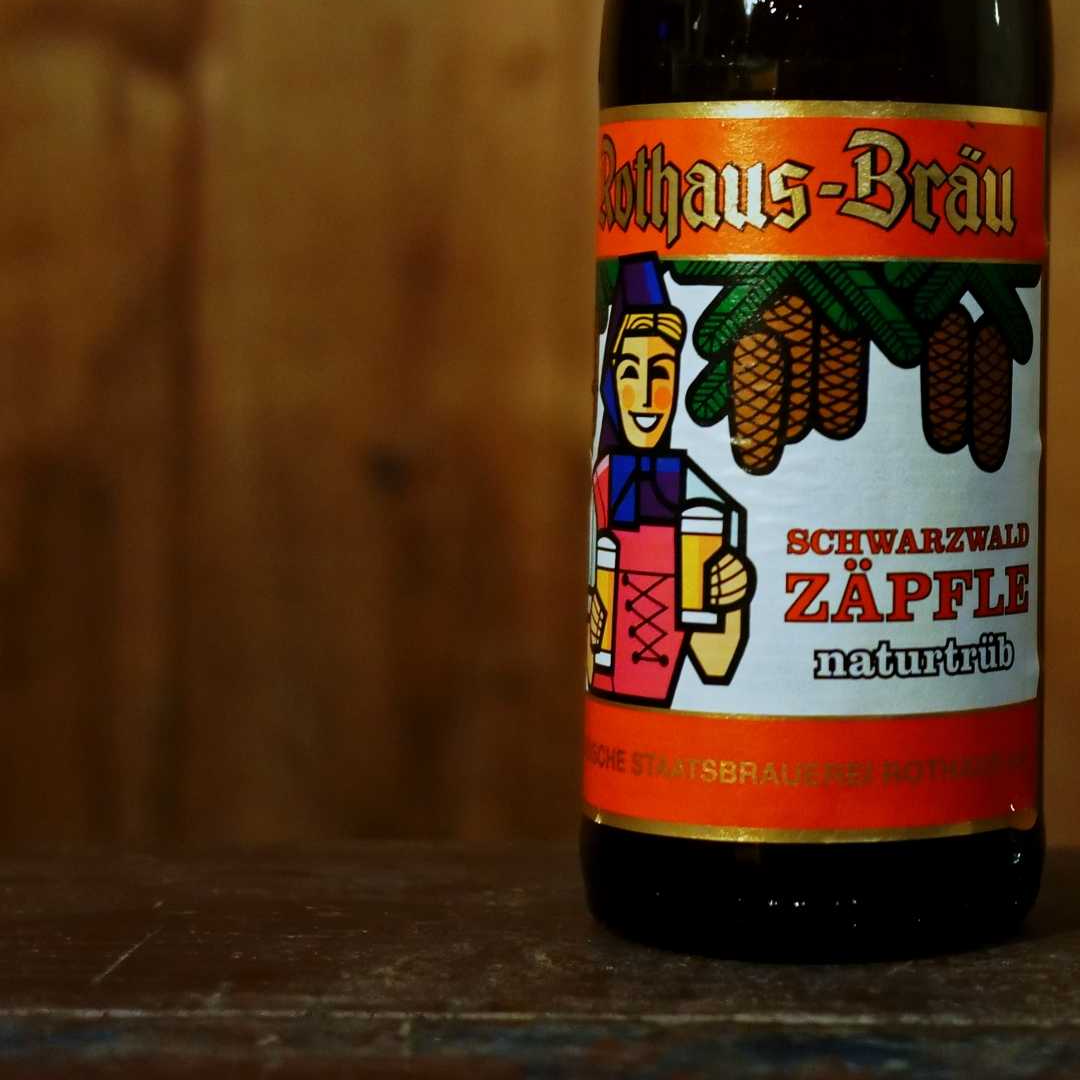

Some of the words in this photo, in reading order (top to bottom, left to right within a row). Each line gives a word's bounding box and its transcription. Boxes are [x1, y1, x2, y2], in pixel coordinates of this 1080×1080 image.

[786, 522, 1030, 555] SCHWARZWALD
[784, 557, 1030, 623] ZÄPFLE
[813, 631, 1015, 680] naturtrüb
[630, 750, 874, 787] STAATSBRAUEREI
